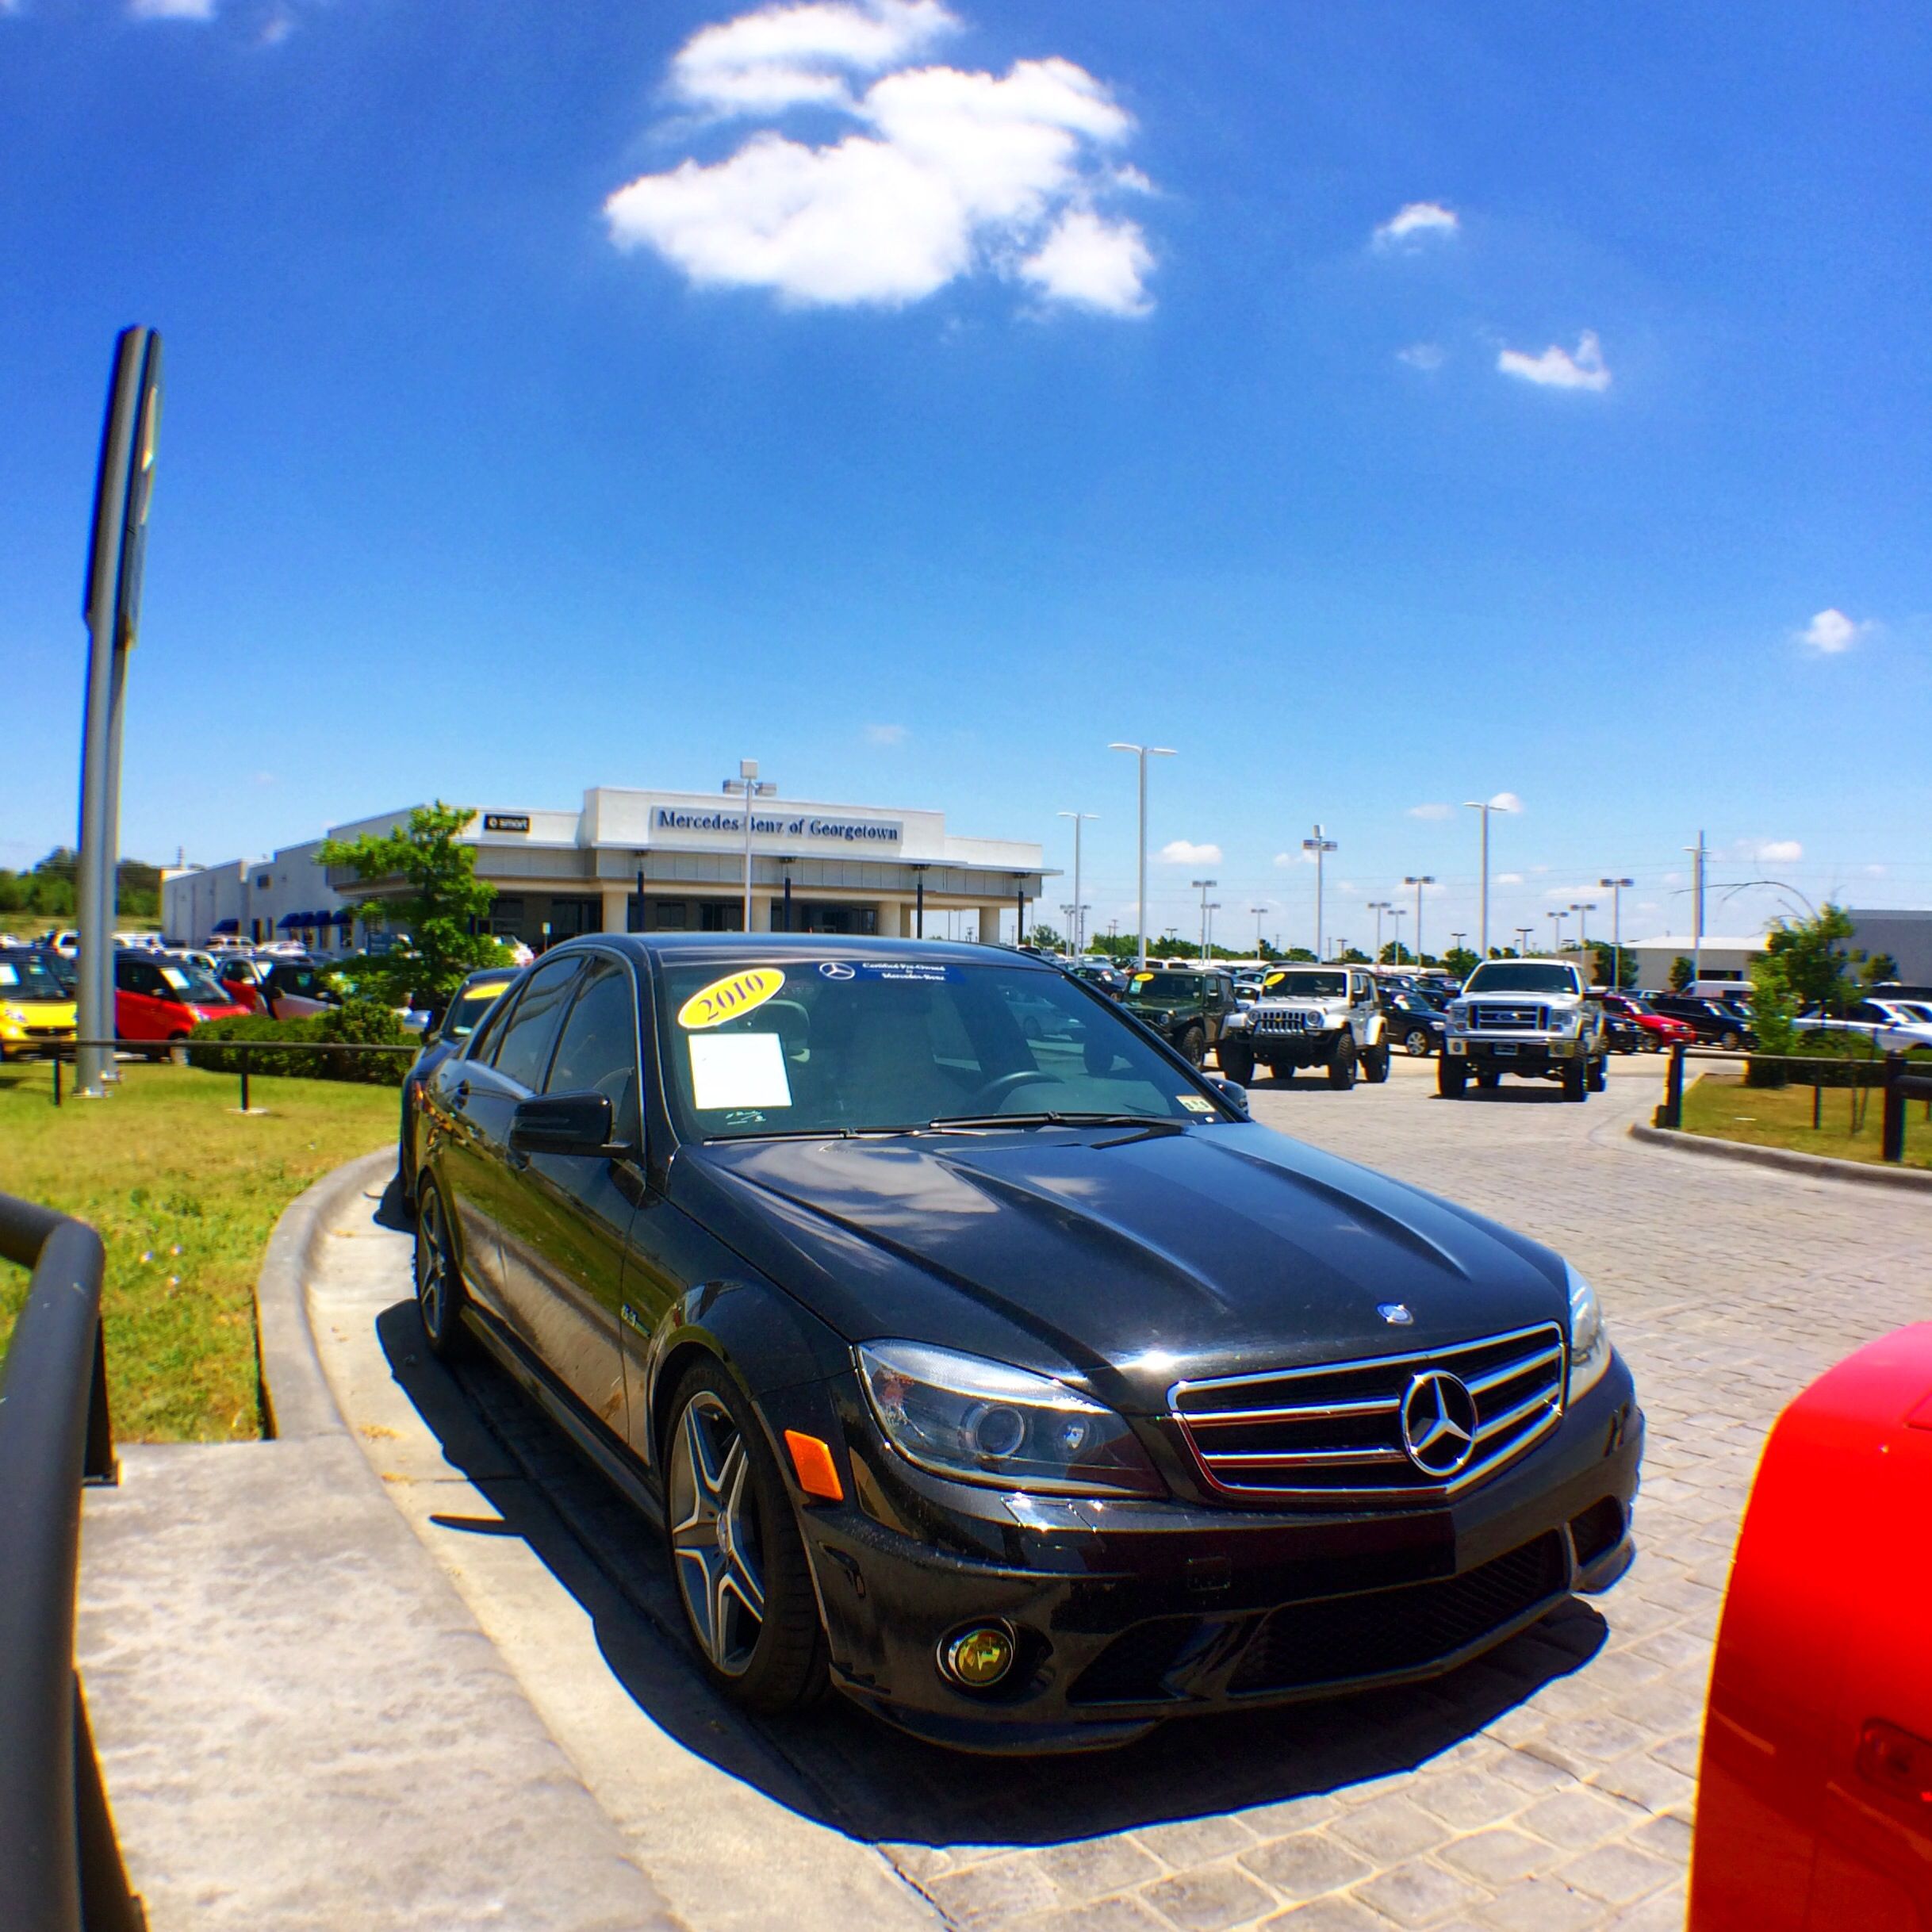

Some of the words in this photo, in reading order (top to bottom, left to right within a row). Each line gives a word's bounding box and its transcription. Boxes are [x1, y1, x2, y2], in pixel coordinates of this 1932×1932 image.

[789, 818, 805, 834] of
[810, 818, 898, 841] Georgetown
[697, 974, 765, 1022] 2010
